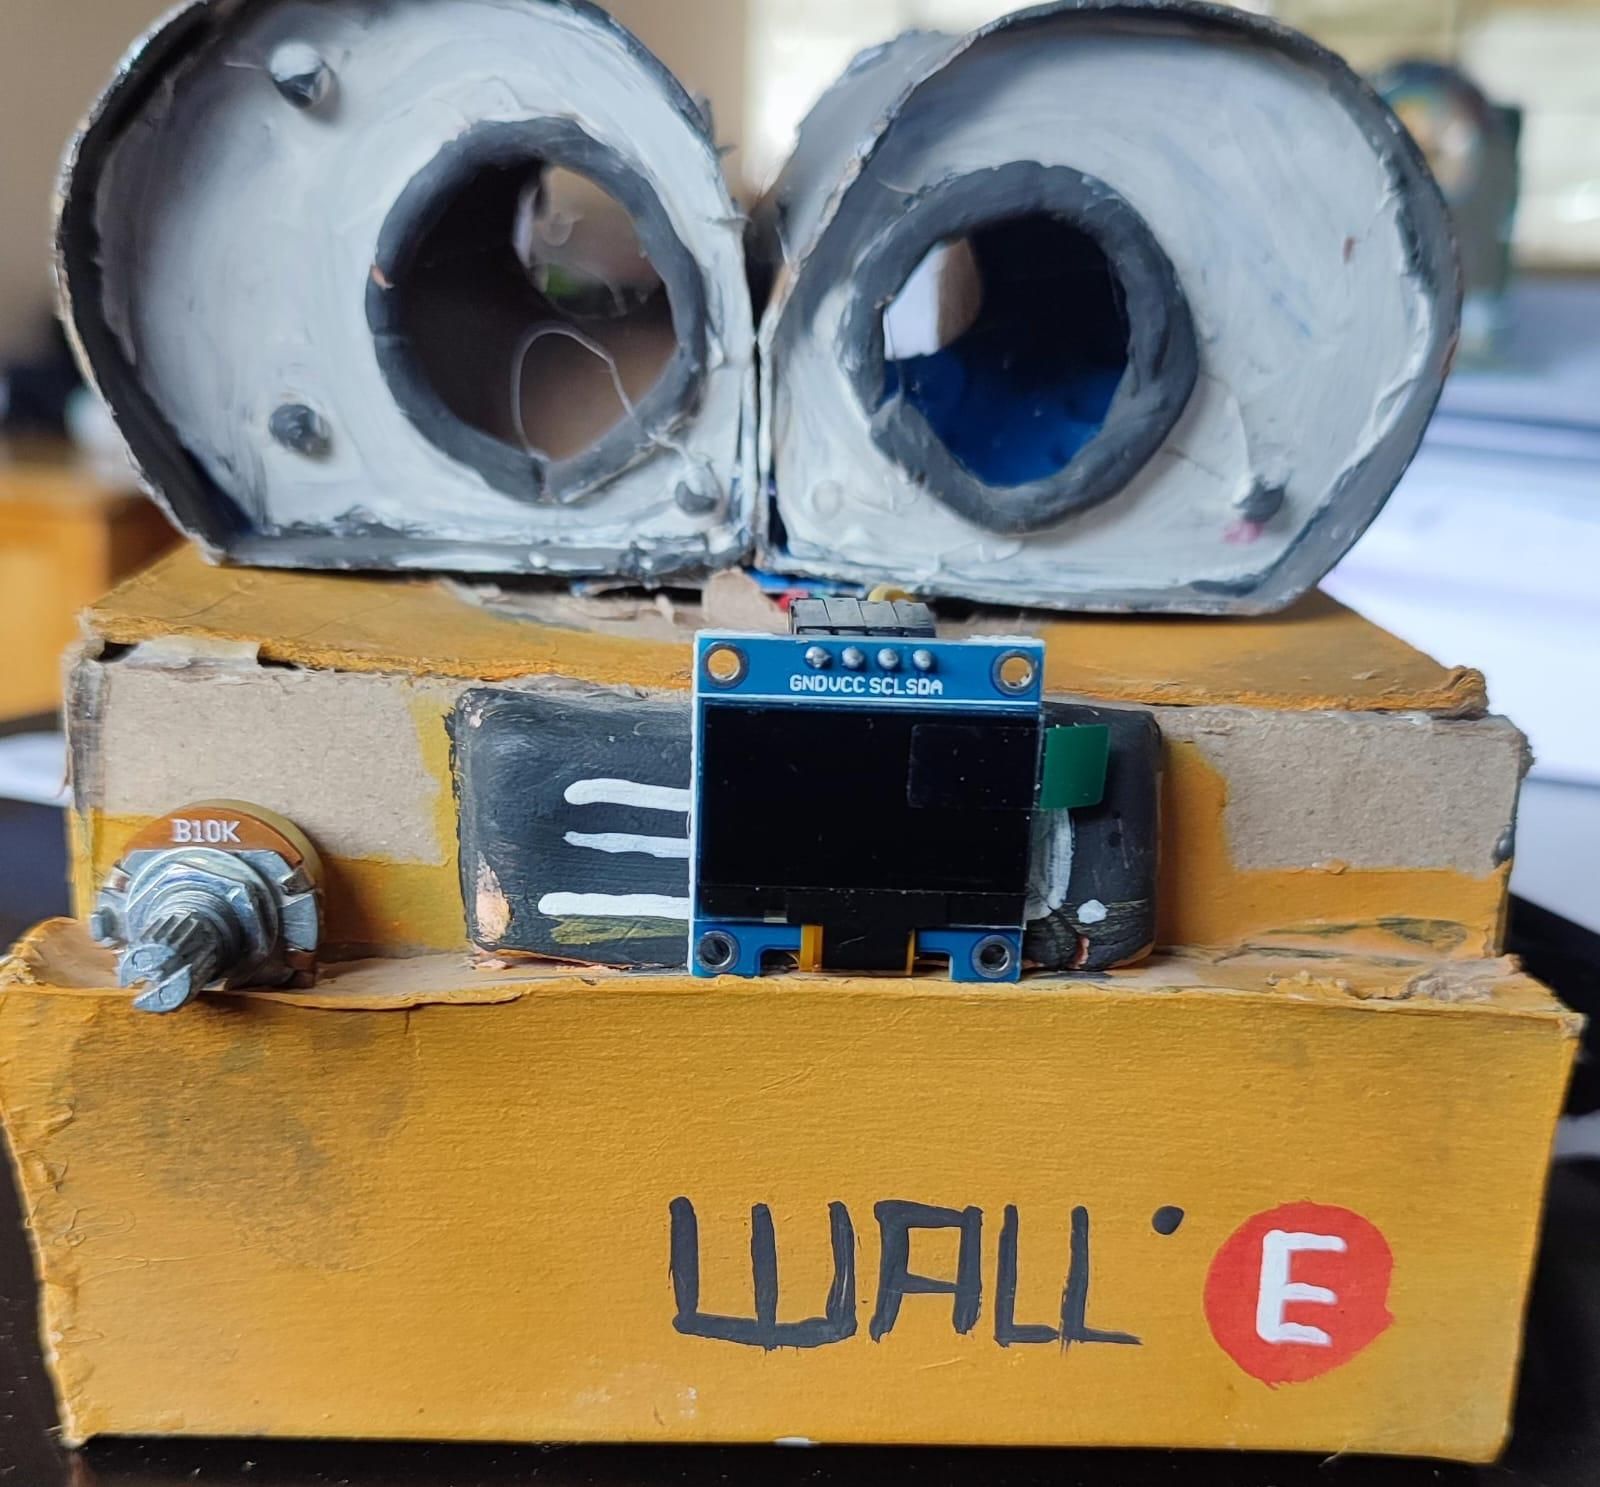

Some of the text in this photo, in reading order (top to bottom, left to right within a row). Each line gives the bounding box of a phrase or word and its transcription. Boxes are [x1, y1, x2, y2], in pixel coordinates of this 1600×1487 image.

[789, 674, 943, 696] GND VCC SCL SDA
[171, 818, 241, 843] B10K
